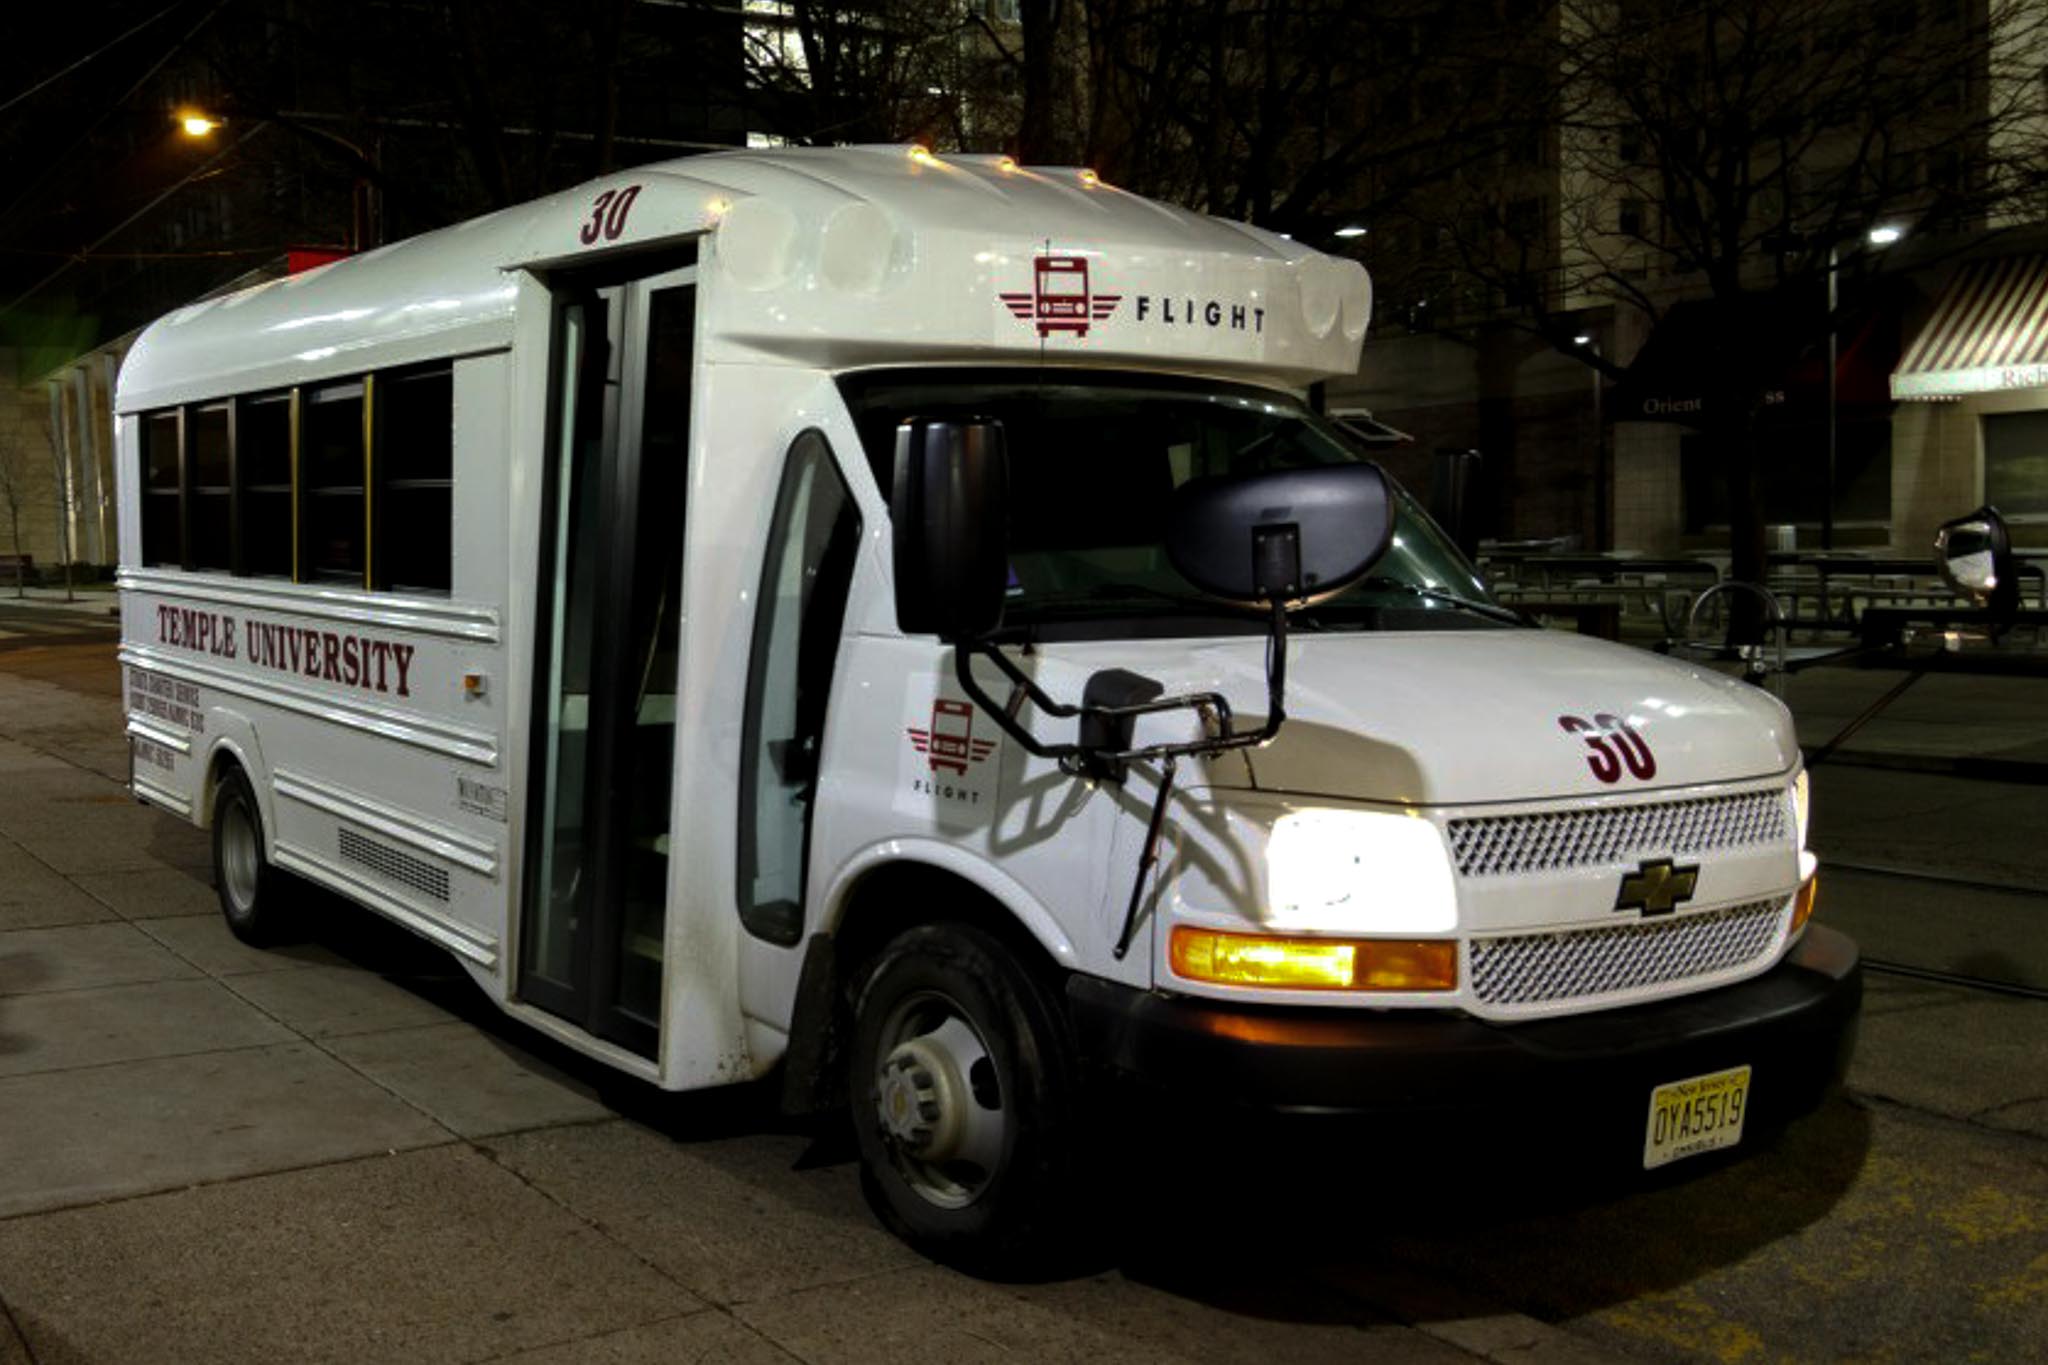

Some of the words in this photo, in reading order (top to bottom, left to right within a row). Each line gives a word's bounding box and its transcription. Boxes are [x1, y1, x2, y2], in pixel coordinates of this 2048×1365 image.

[580, 185, 642, 245] 30
[1136, 295, 1265, 333] FLIGHT
[157, 604, 236, 660] TEMPLE
[245, 620, 415, 697] UNIVERSITY
[1558, 713, 1657, 784] 30
[912, 779, 980, 804] FLIGHT
